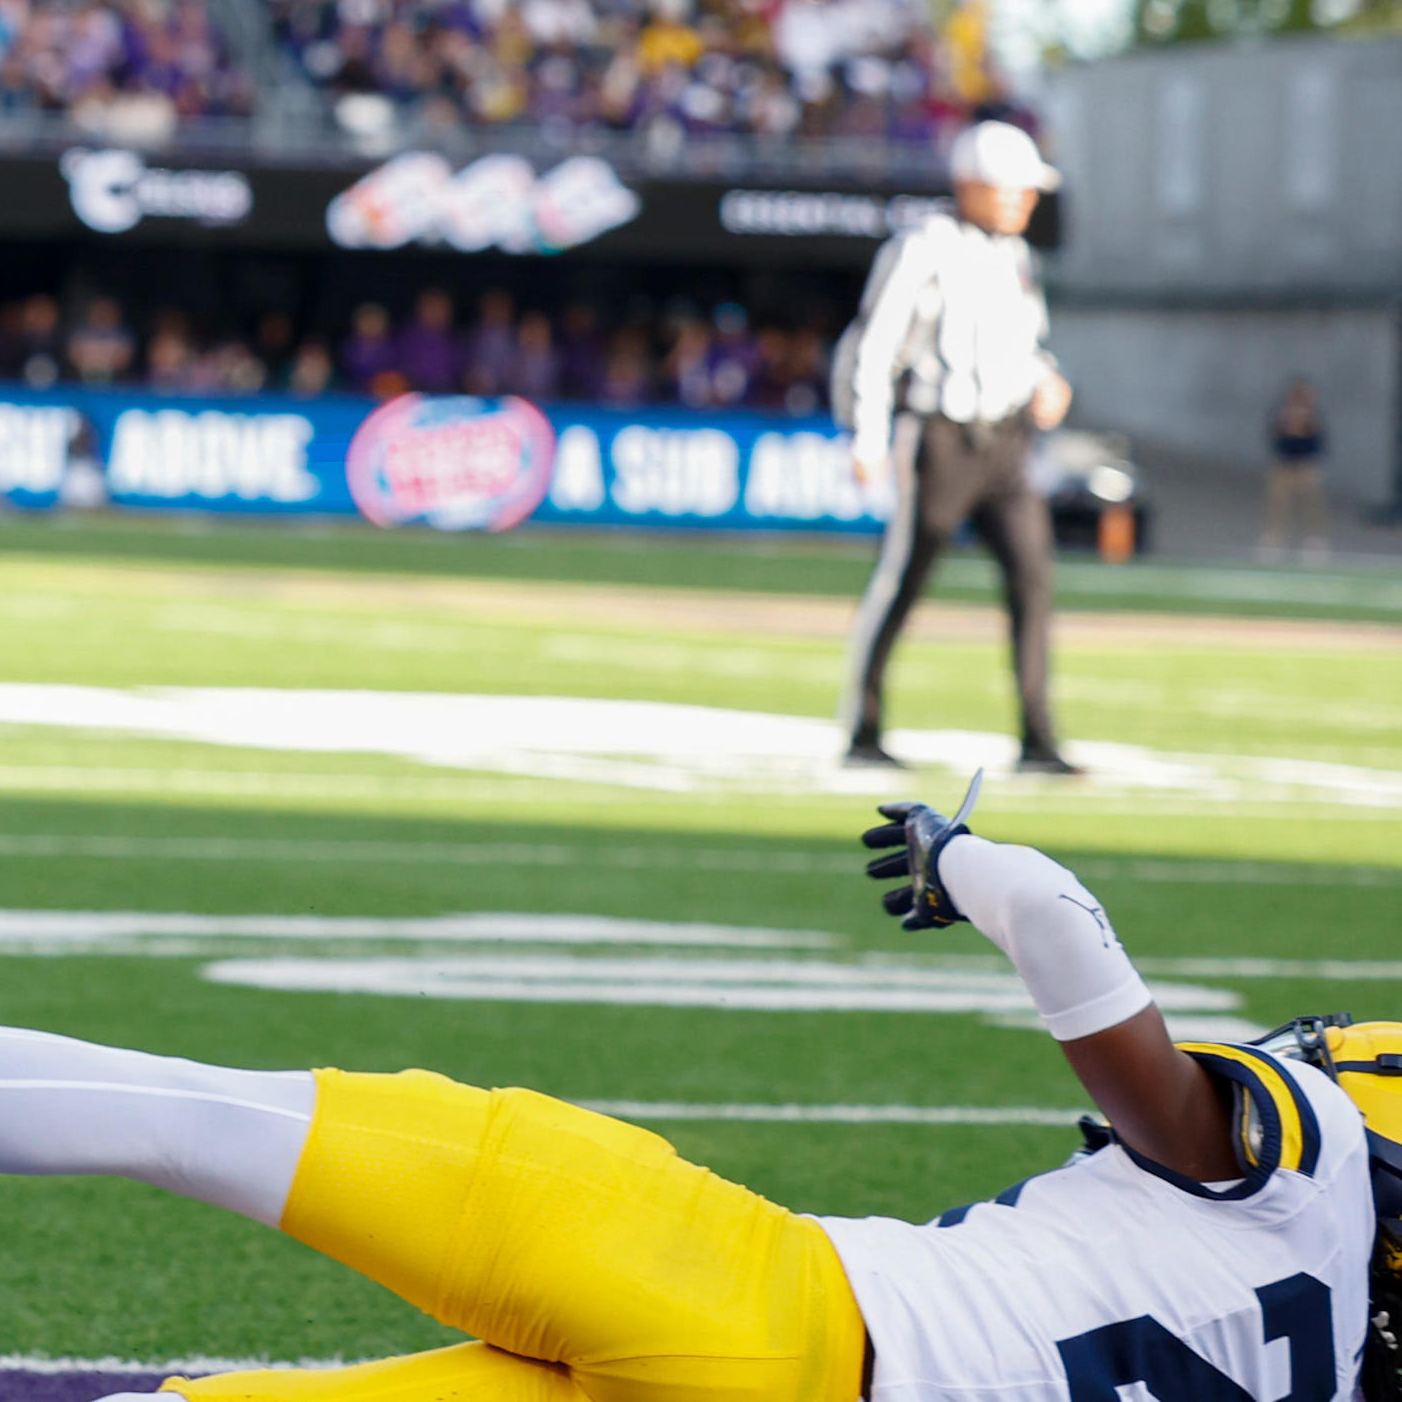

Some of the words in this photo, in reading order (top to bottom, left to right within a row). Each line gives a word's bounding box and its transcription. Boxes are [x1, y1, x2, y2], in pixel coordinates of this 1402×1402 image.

[107, 409, 321, 502] ABOVE
[548, 425, 603, 511] A
[610, 425, 739, 515] SUB
